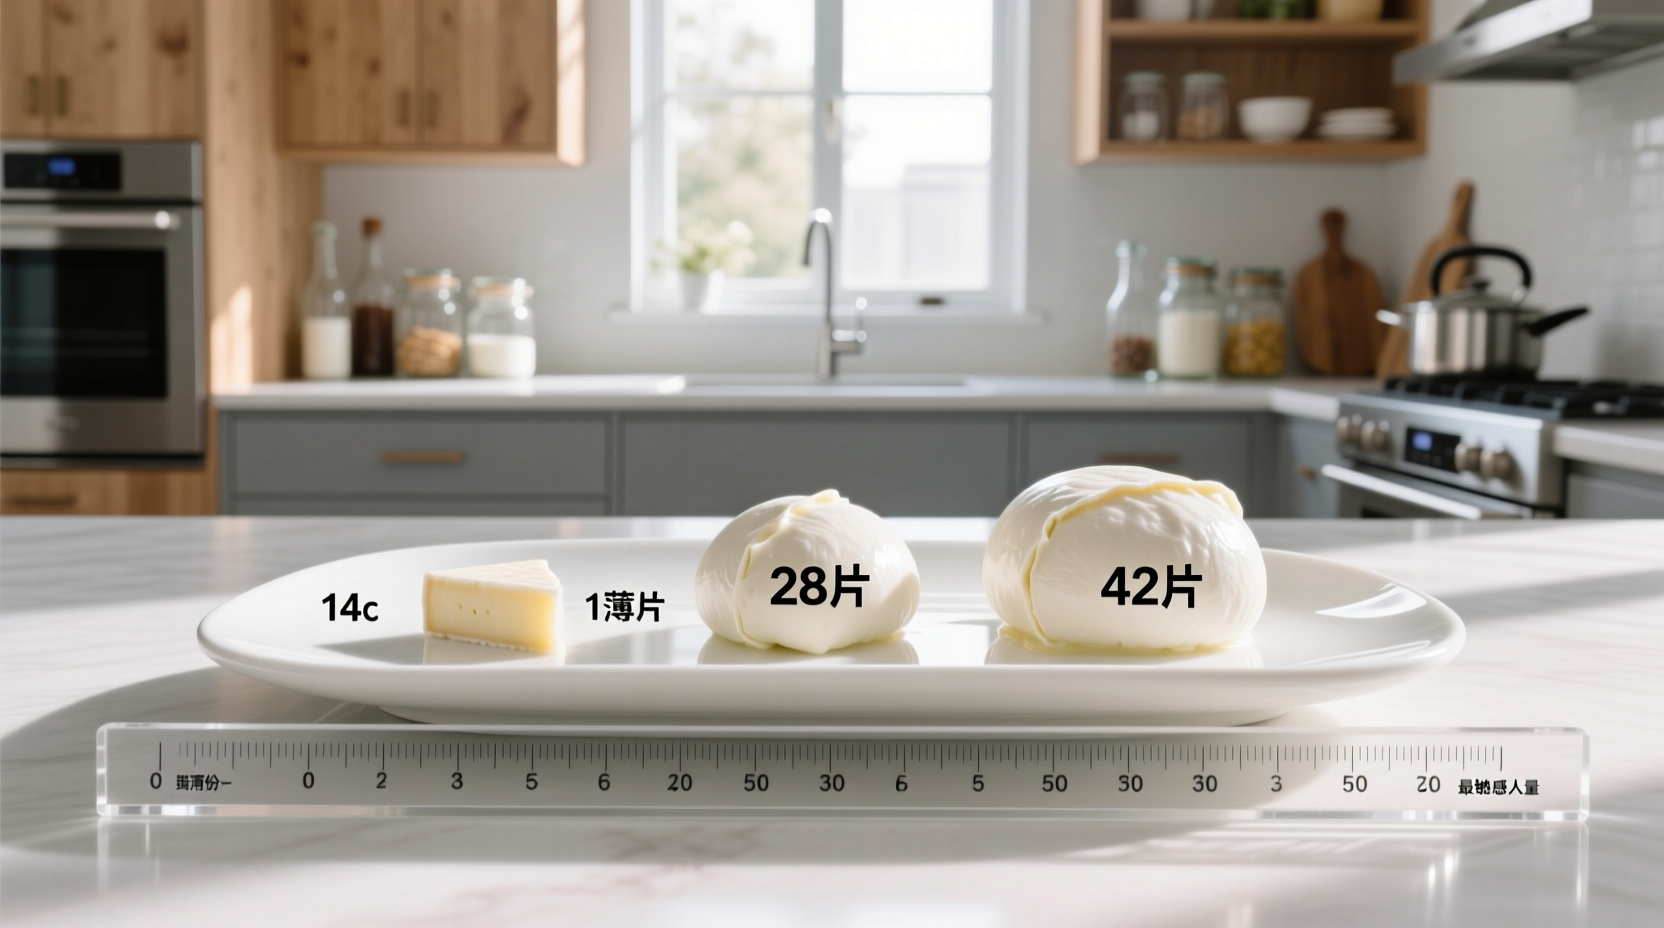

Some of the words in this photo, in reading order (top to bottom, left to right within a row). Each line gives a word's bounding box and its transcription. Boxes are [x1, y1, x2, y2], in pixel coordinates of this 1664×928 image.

[149, 773, 163, 791] 0
[302, 773, 315, 791] 0
[375, 773, 388, 791] 2
[450, 773, 464, 791] 3
[525, 773, 539, 791] 5
[597, 773, 611, 792] 6
[666, 773, 693, 792] 20
[743, 773, 770, 793] 50
[818, 774, 846, 793] 30
[971, 774, 985, 793] 5
[1041, 774, 1069, 793] 50
[1117, 774, 1144, 793] 30
[1191, 774, 1218, 793] 30
[1270, 774, 1283, 793] 3
[1342, 774, 1368, 794] 50
